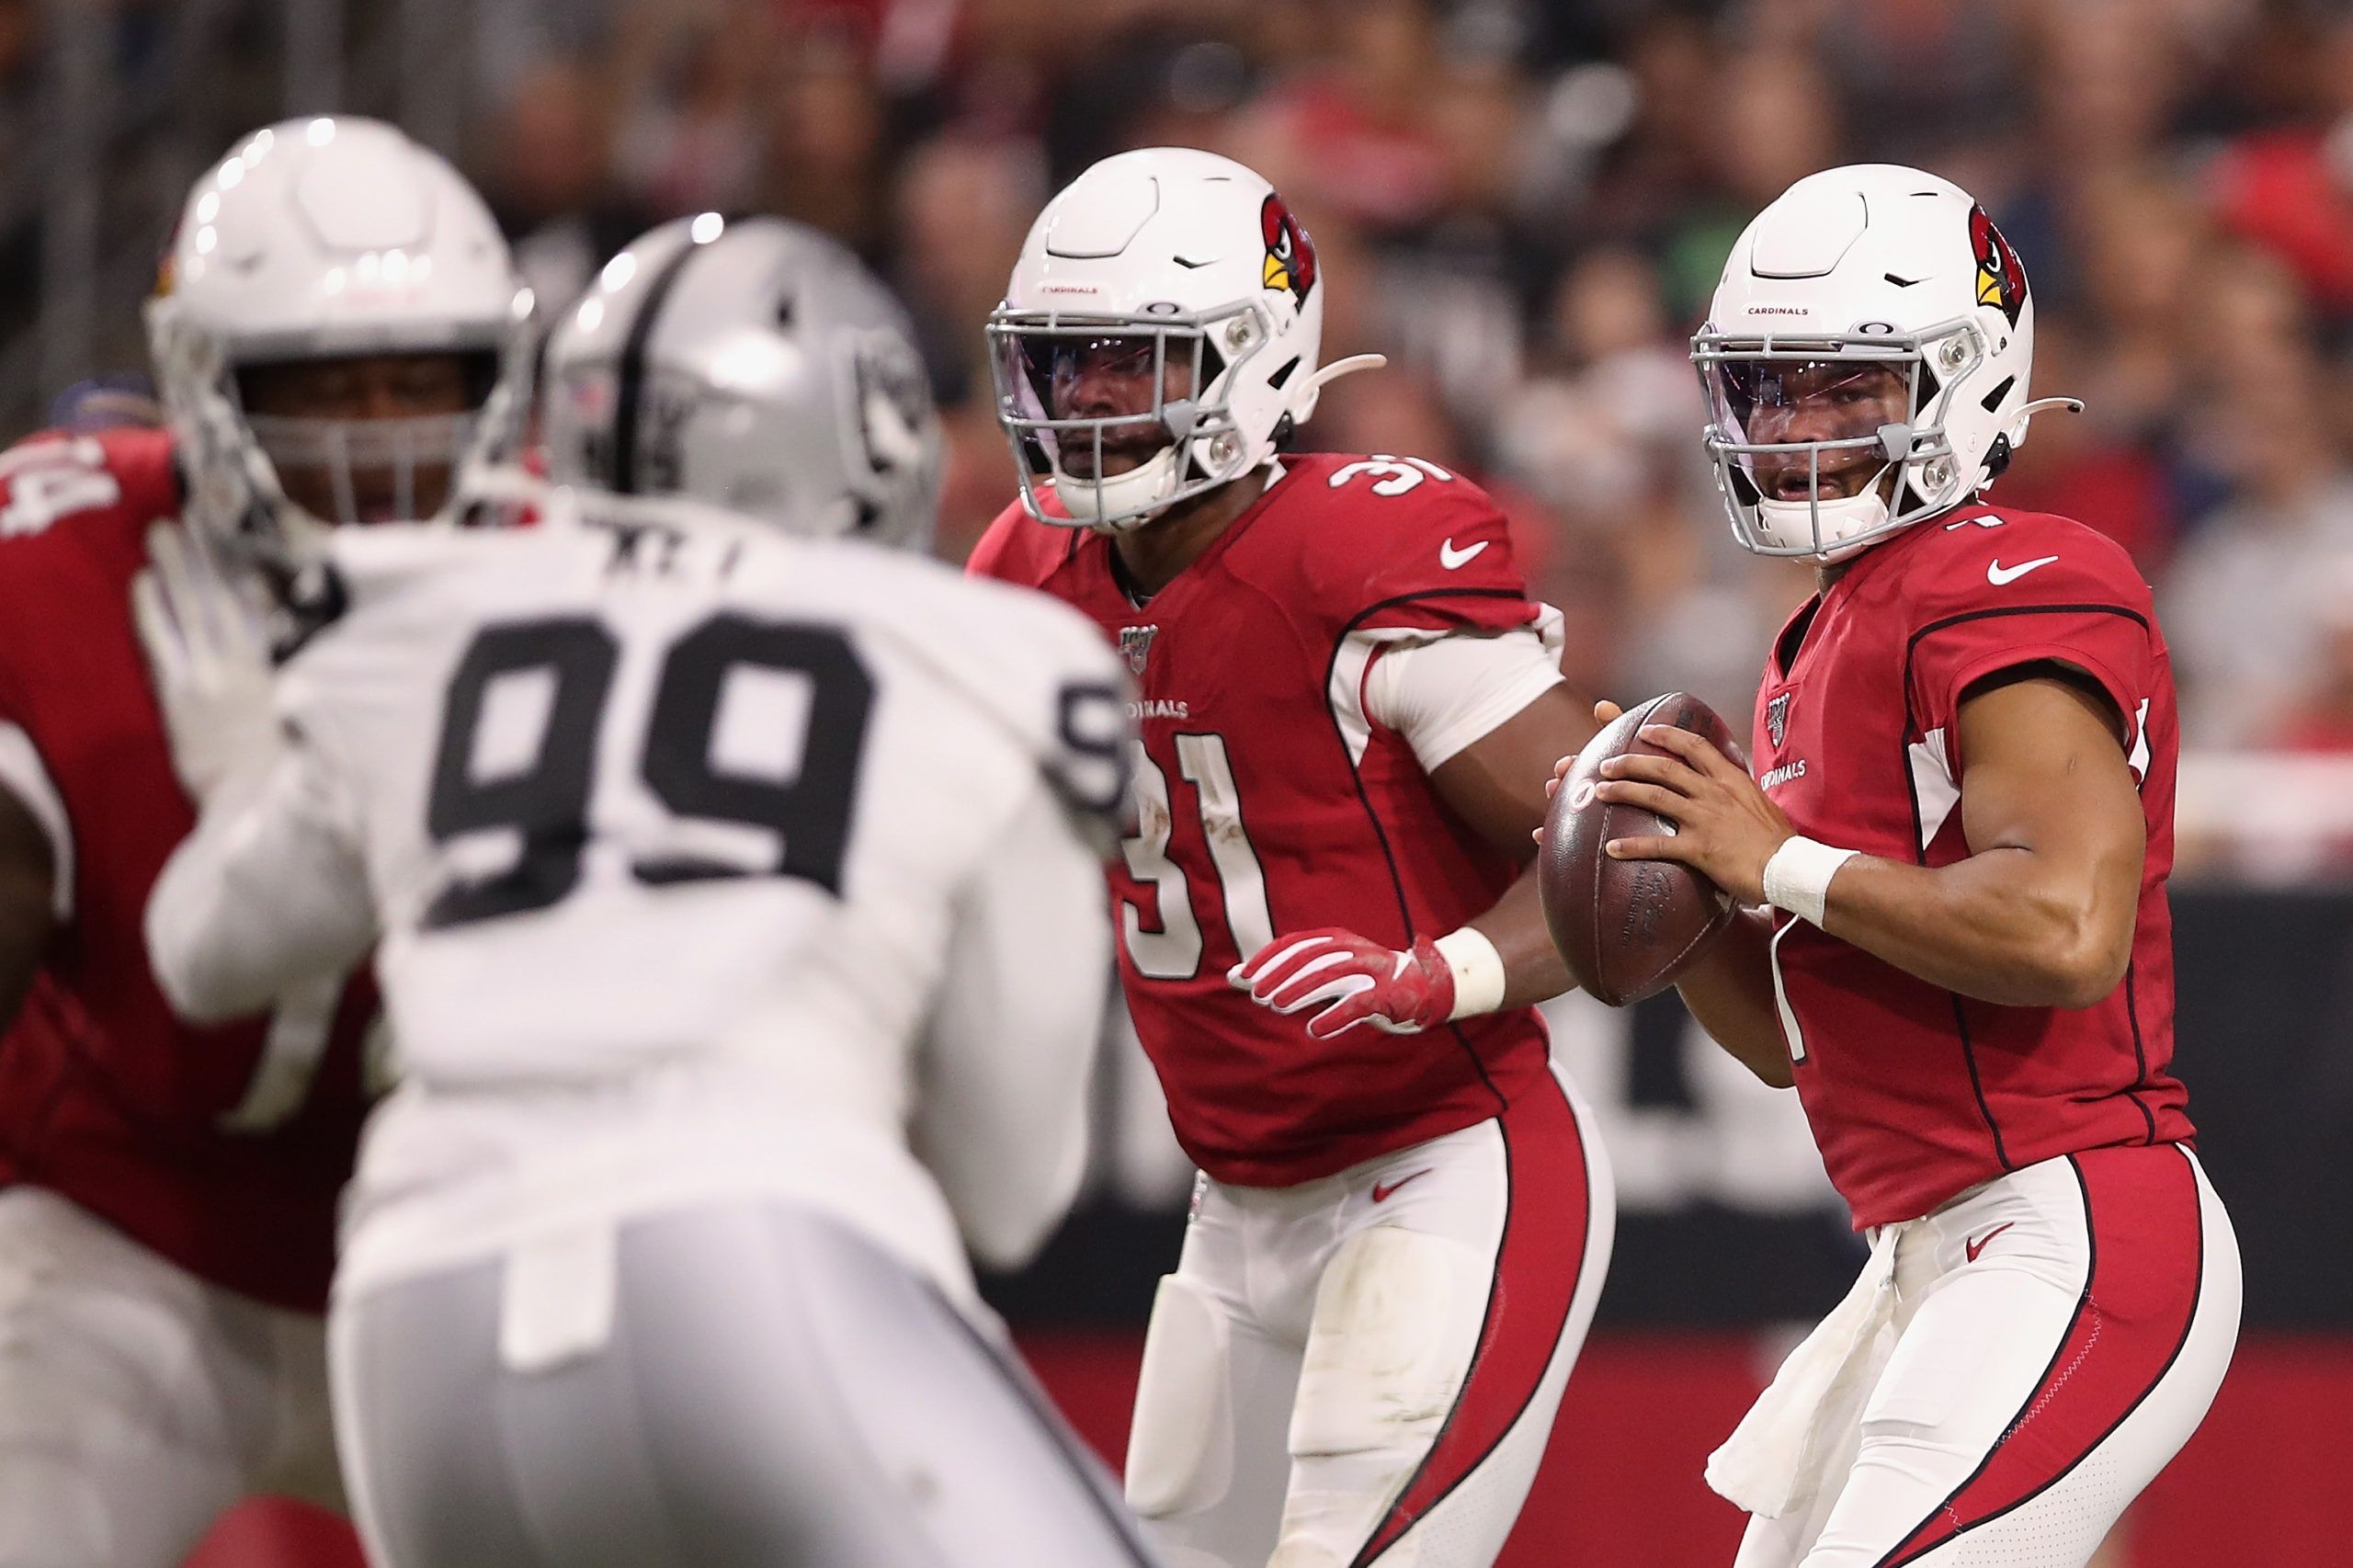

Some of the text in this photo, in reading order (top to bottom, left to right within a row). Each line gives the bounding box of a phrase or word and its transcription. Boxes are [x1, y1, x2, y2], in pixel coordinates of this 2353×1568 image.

[1747, 307, 1809, 315] CARDINALS
[416, 610, 880, 933] 99
[1123, 699, 1188, 720] DINALS
[1118, 732, 1276, 980] 31
